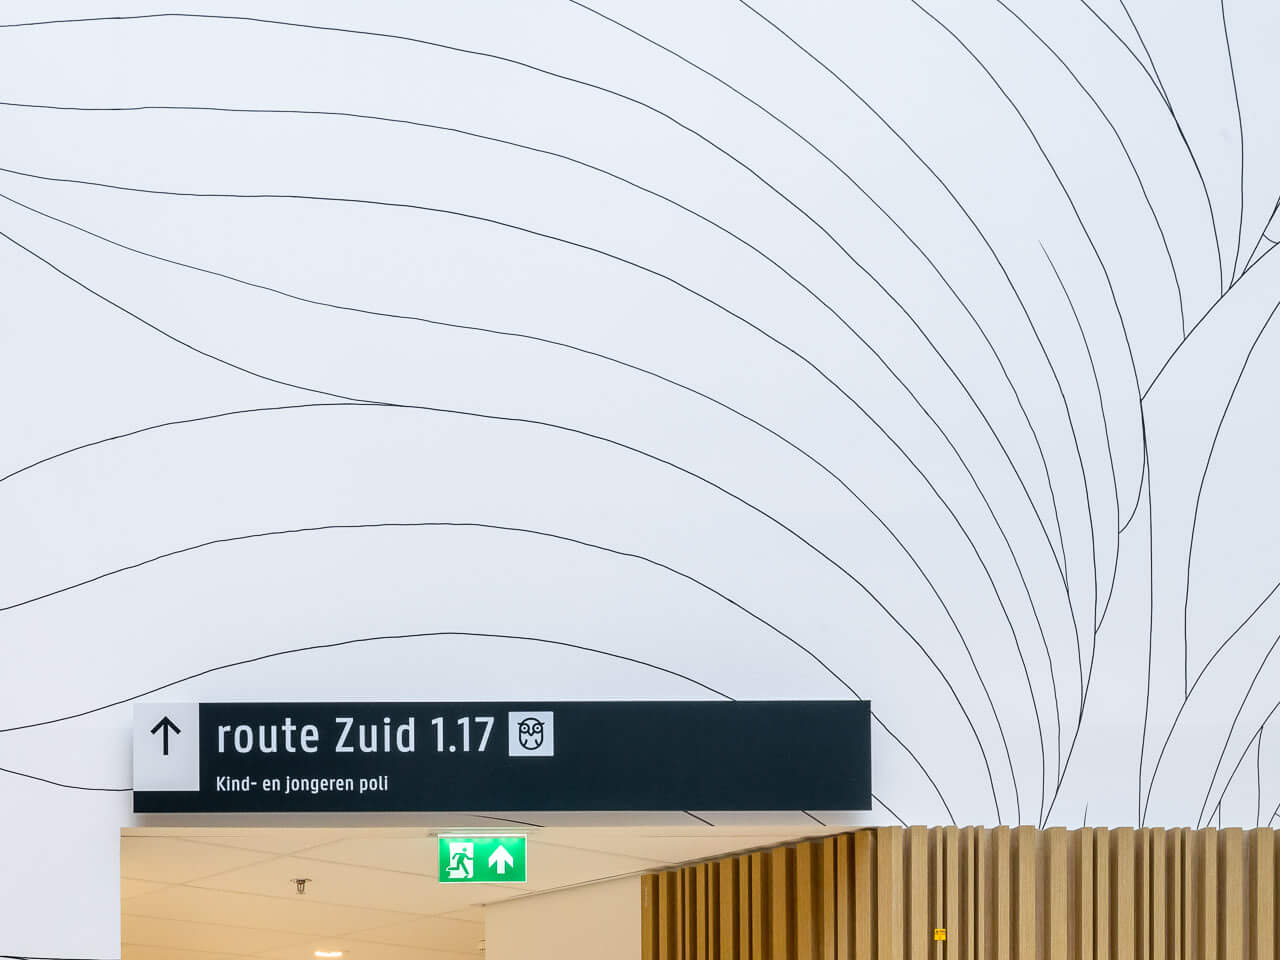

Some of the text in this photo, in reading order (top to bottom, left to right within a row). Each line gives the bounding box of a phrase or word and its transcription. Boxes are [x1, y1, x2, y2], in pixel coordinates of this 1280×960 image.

[218, 716, 495, 753] route Zuid 1.17
[216, 775, 388, 795] Kind- en jongeren poli
